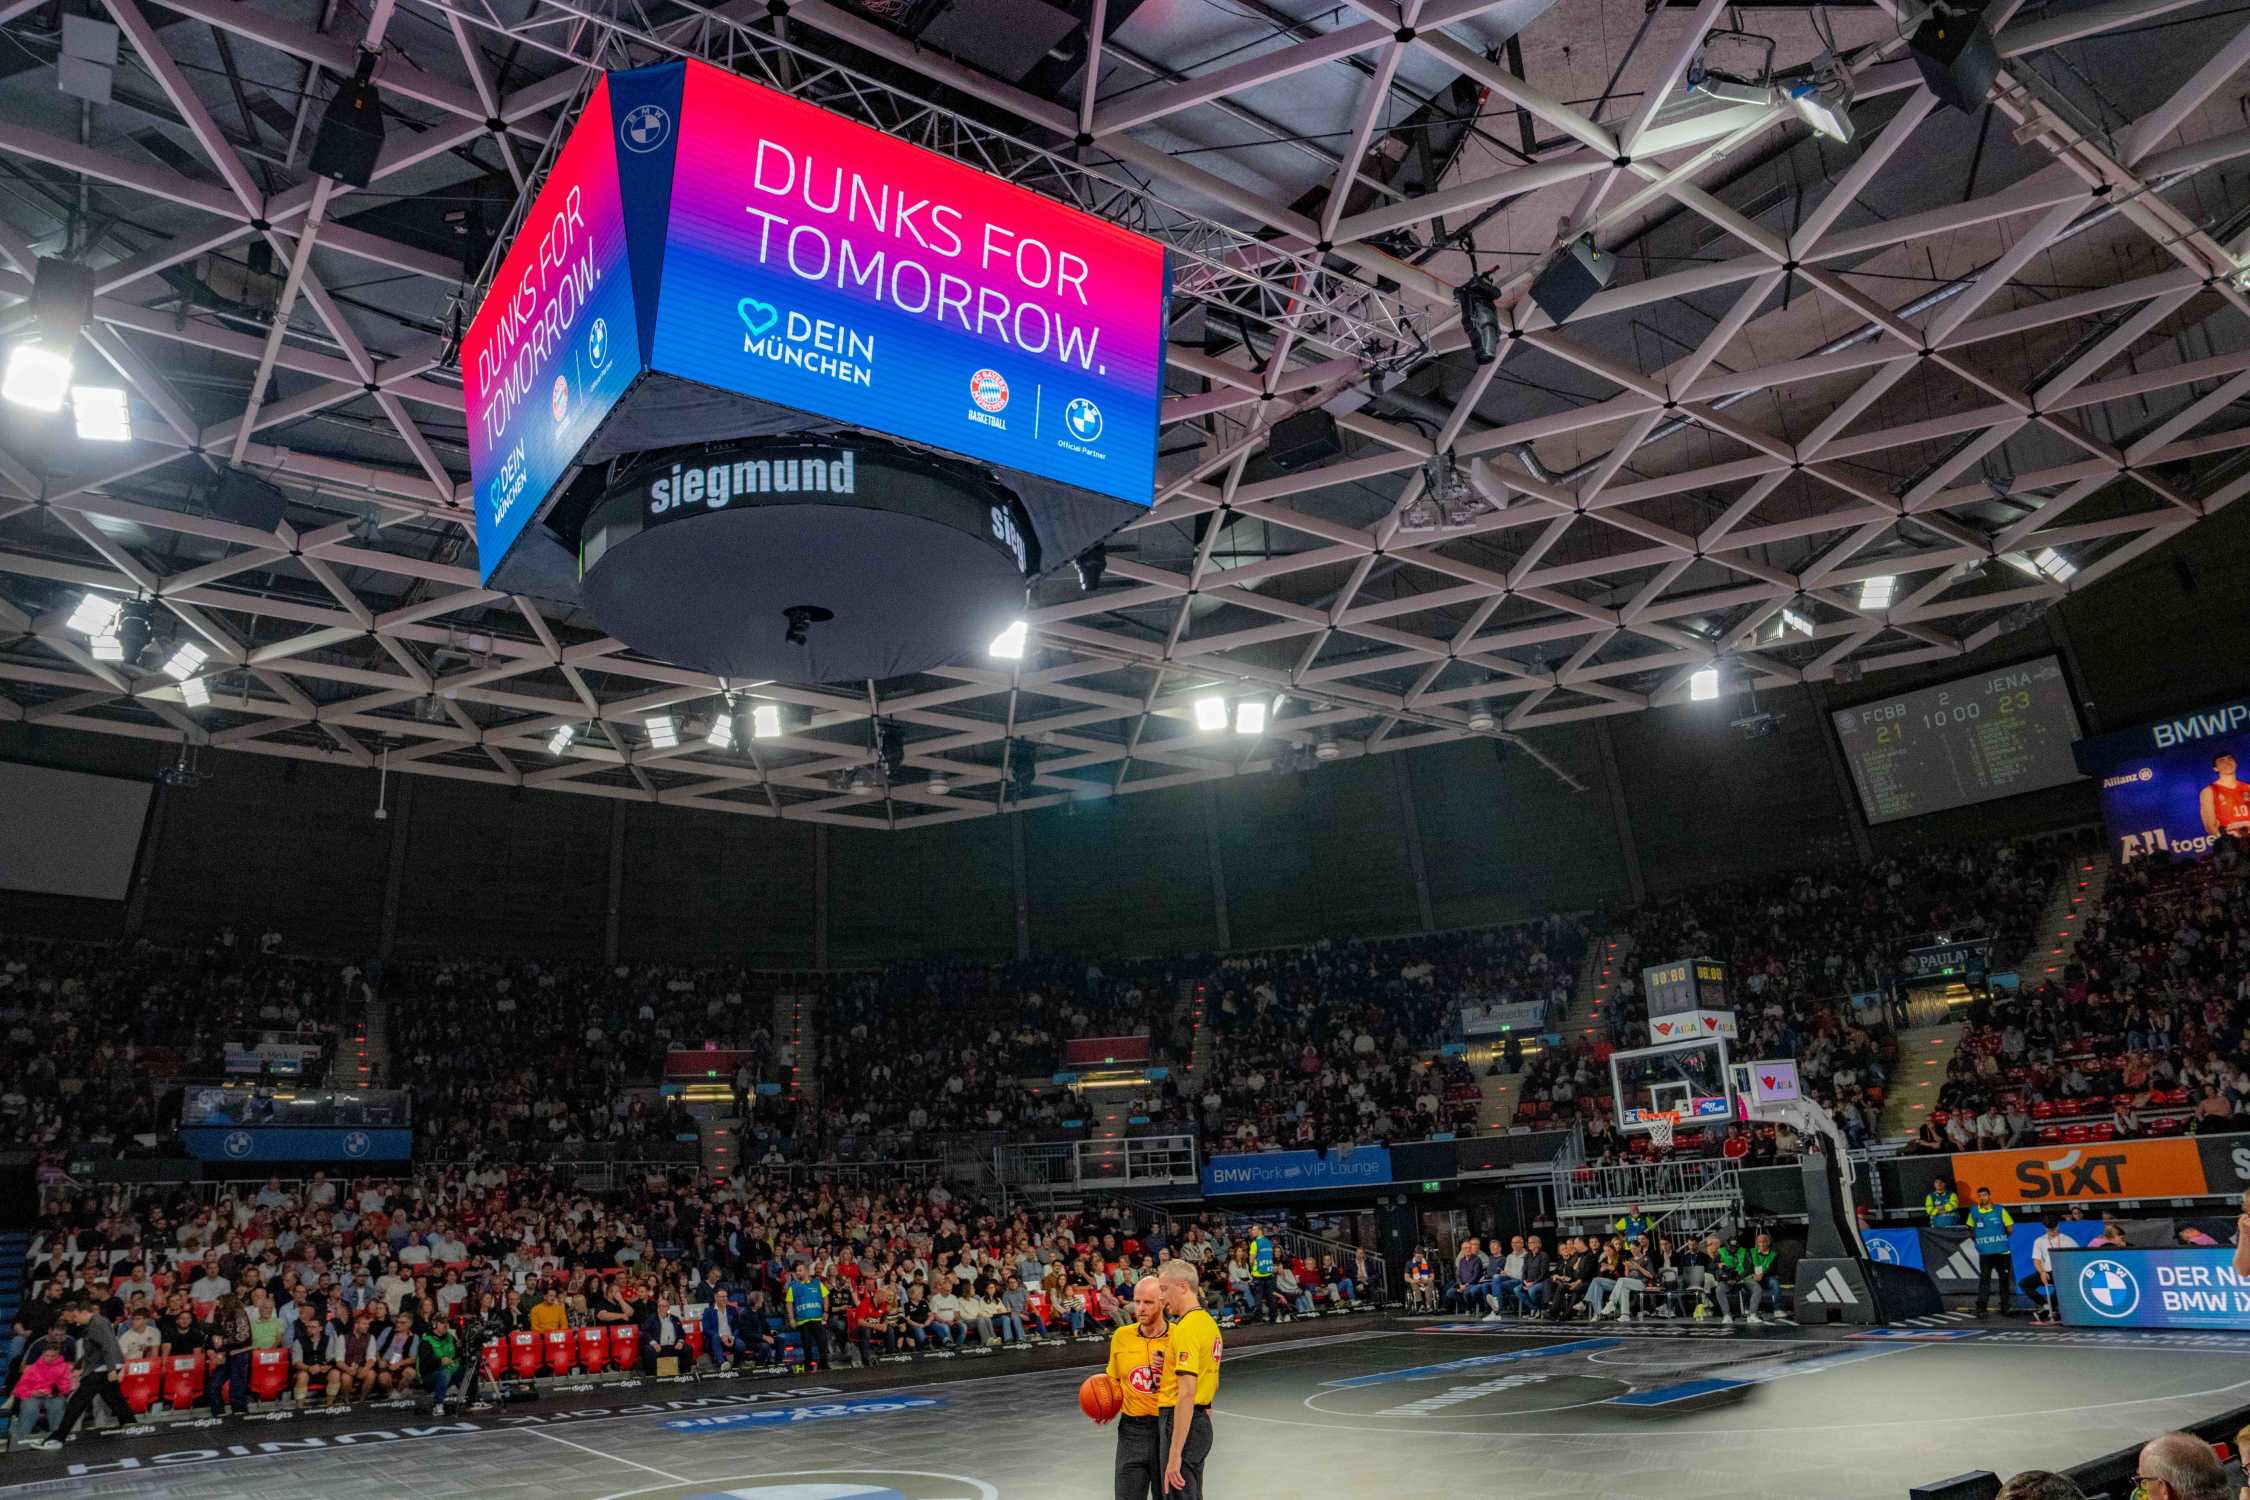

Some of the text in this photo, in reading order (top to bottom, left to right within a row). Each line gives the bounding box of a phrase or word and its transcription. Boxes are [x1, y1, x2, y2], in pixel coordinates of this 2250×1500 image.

[753, 138, 1089, 306] DUNKS FOR
[479, 185, 584, 399] DUNKS FOR
[746, 206, 1106, 376] TOMORROW.
[483, 235, 600, 451] TOMORROW.
[787, 310, 874, 364] DEIN
[743, 332, 871, 388] MÜNCHEN
[967, 409, 1007, 431] BASKETBALL
[1057, 440, 1107, 460] Official Partner
[501, 437, 526, 493] DEIN
[650, 450, 855, 514] siegmund
[494, 469, 527, 528] MÜNCHEN
[1984, 671, 2033, 695] JENA
[1938, 691, 1950, 706] 2
[2000, 691, 2030, 714] 23
[1862, 703, 1907, 725] FCBB
[1876, 722, 1902, 744] 21
[2103, 773, 2138, 789] Allianz
[1214, 1160, 1380, 1183] BMWPark VIP Lounge
[2085, 1263, 2127, 1280] BMW
[2156, 1266, 2212, 1287] DER
[2162, 1291, 2227, 1312] BMW
[193, 1417, 222, 1428] digits
[266, 1410, 293, 1421] digits
[67, 1386, 843, 1476] BMWPark MUNICH
[125, 1424, 156, 1437] digits
